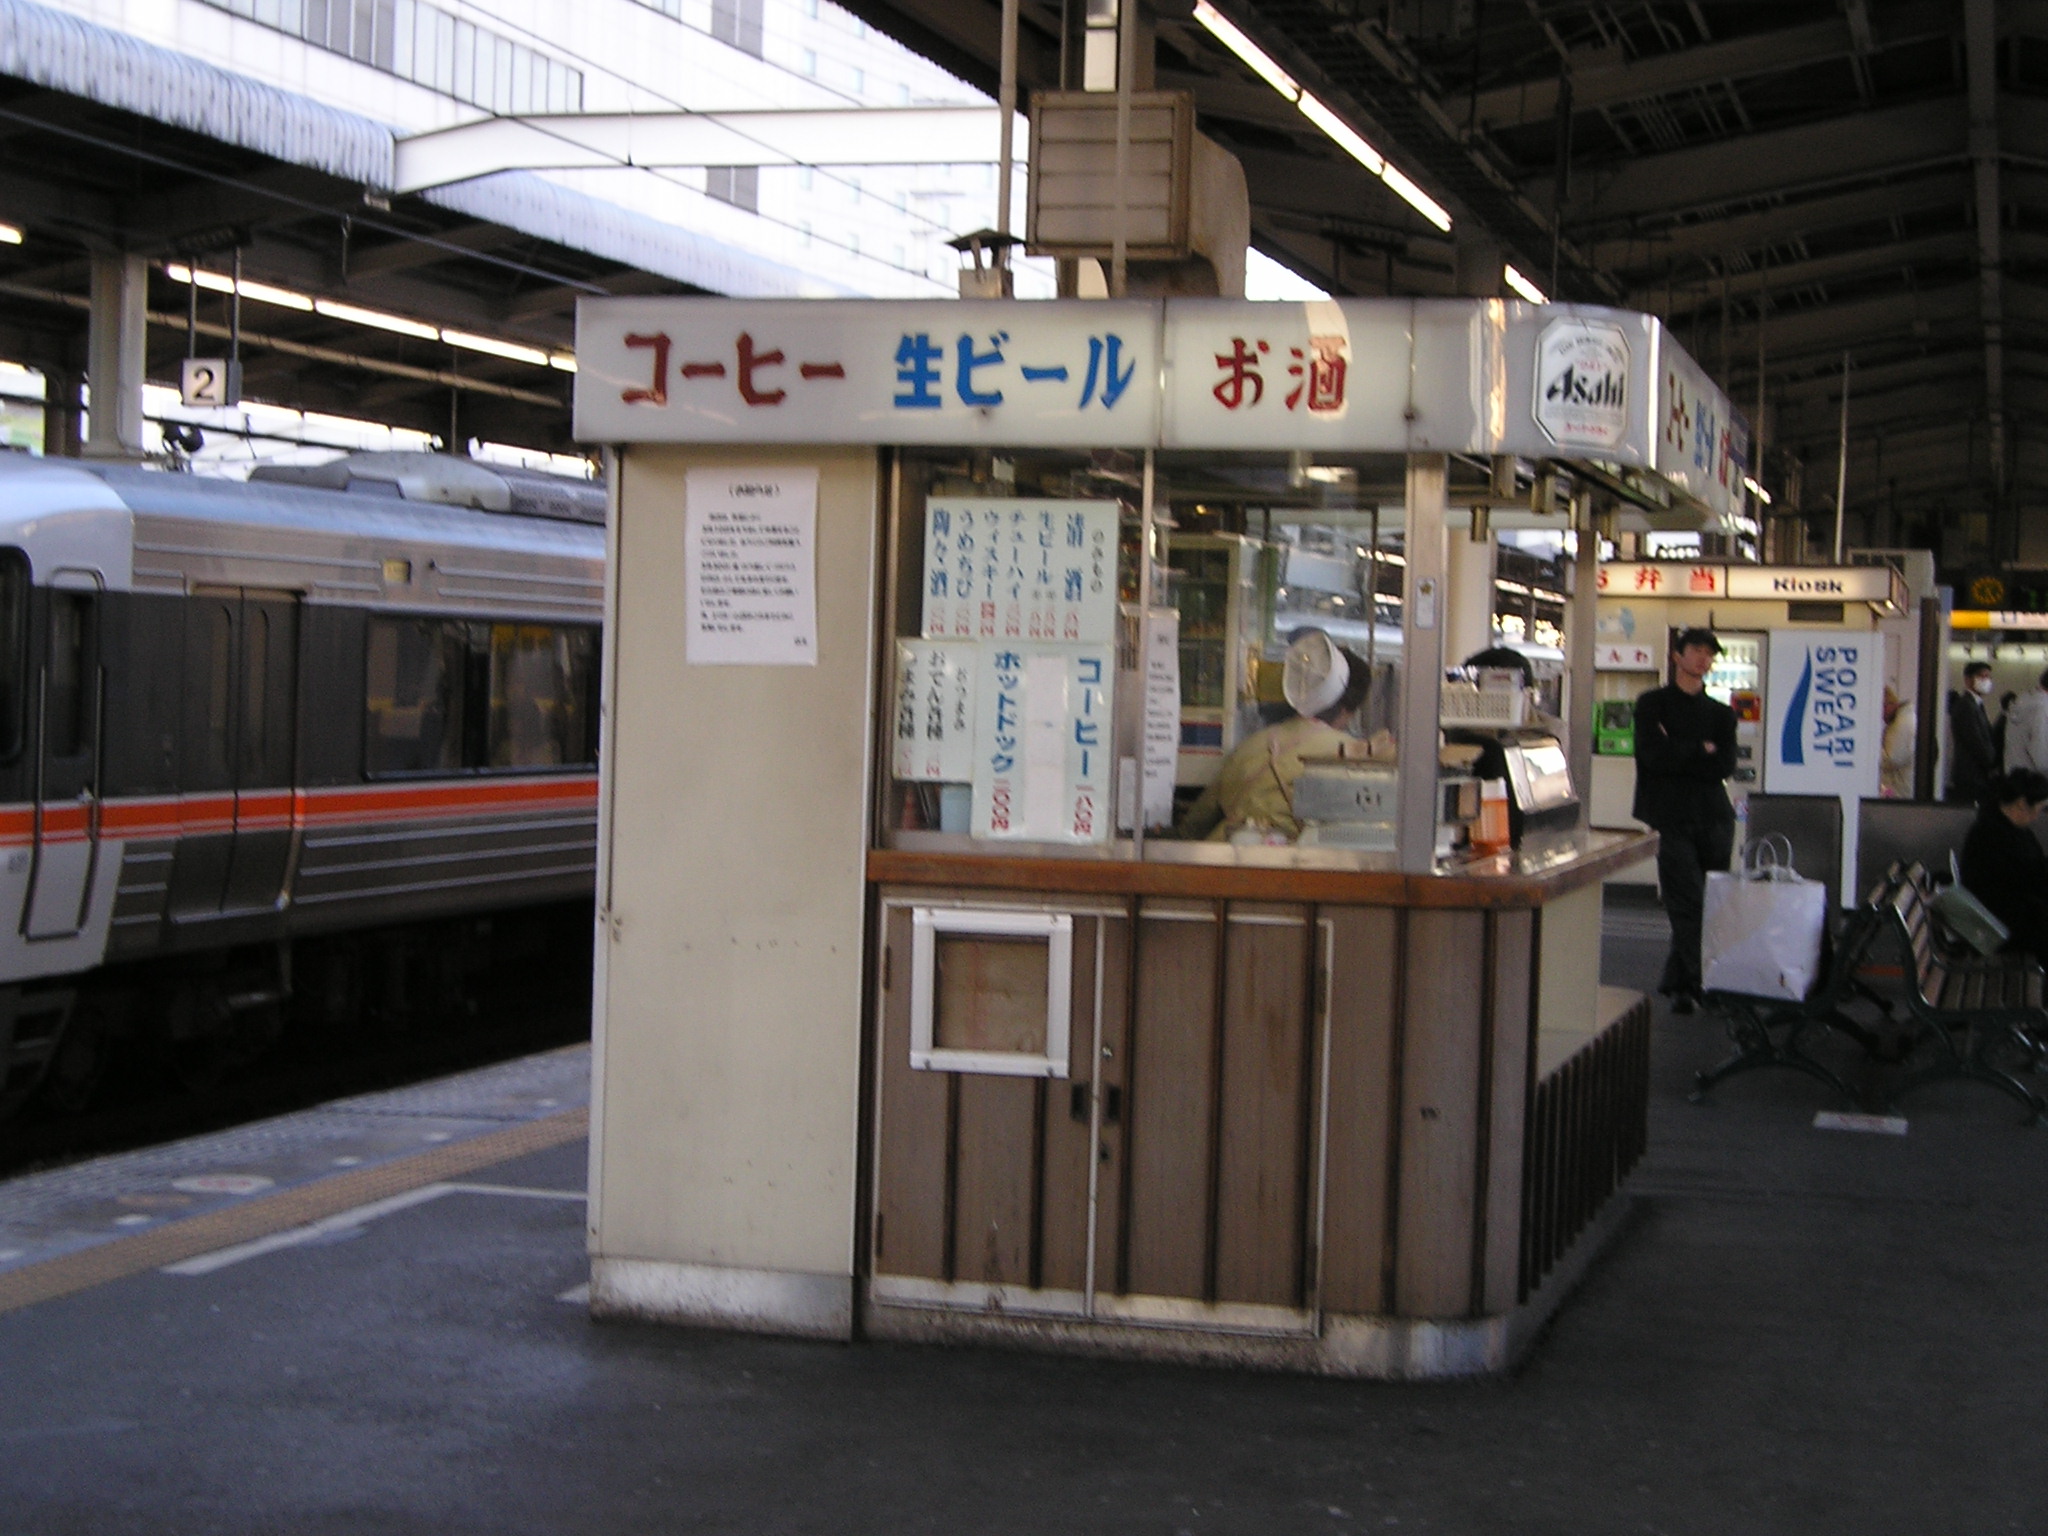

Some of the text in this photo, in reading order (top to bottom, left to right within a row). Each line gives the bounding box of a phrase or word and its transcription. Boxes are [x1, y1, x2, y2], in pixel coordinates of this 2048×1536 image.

[193, 366, 215, 400] 2
[622, 331, 1348, 411] コーヒー 生ビール お酒
[1546, 363, 1625, 408] Asahi
[1074, 658, 1102, 777] コーヒー
[1813, 646, 1836, 757] SWEAT
[1834, 646, 1858, 767] POCARI
